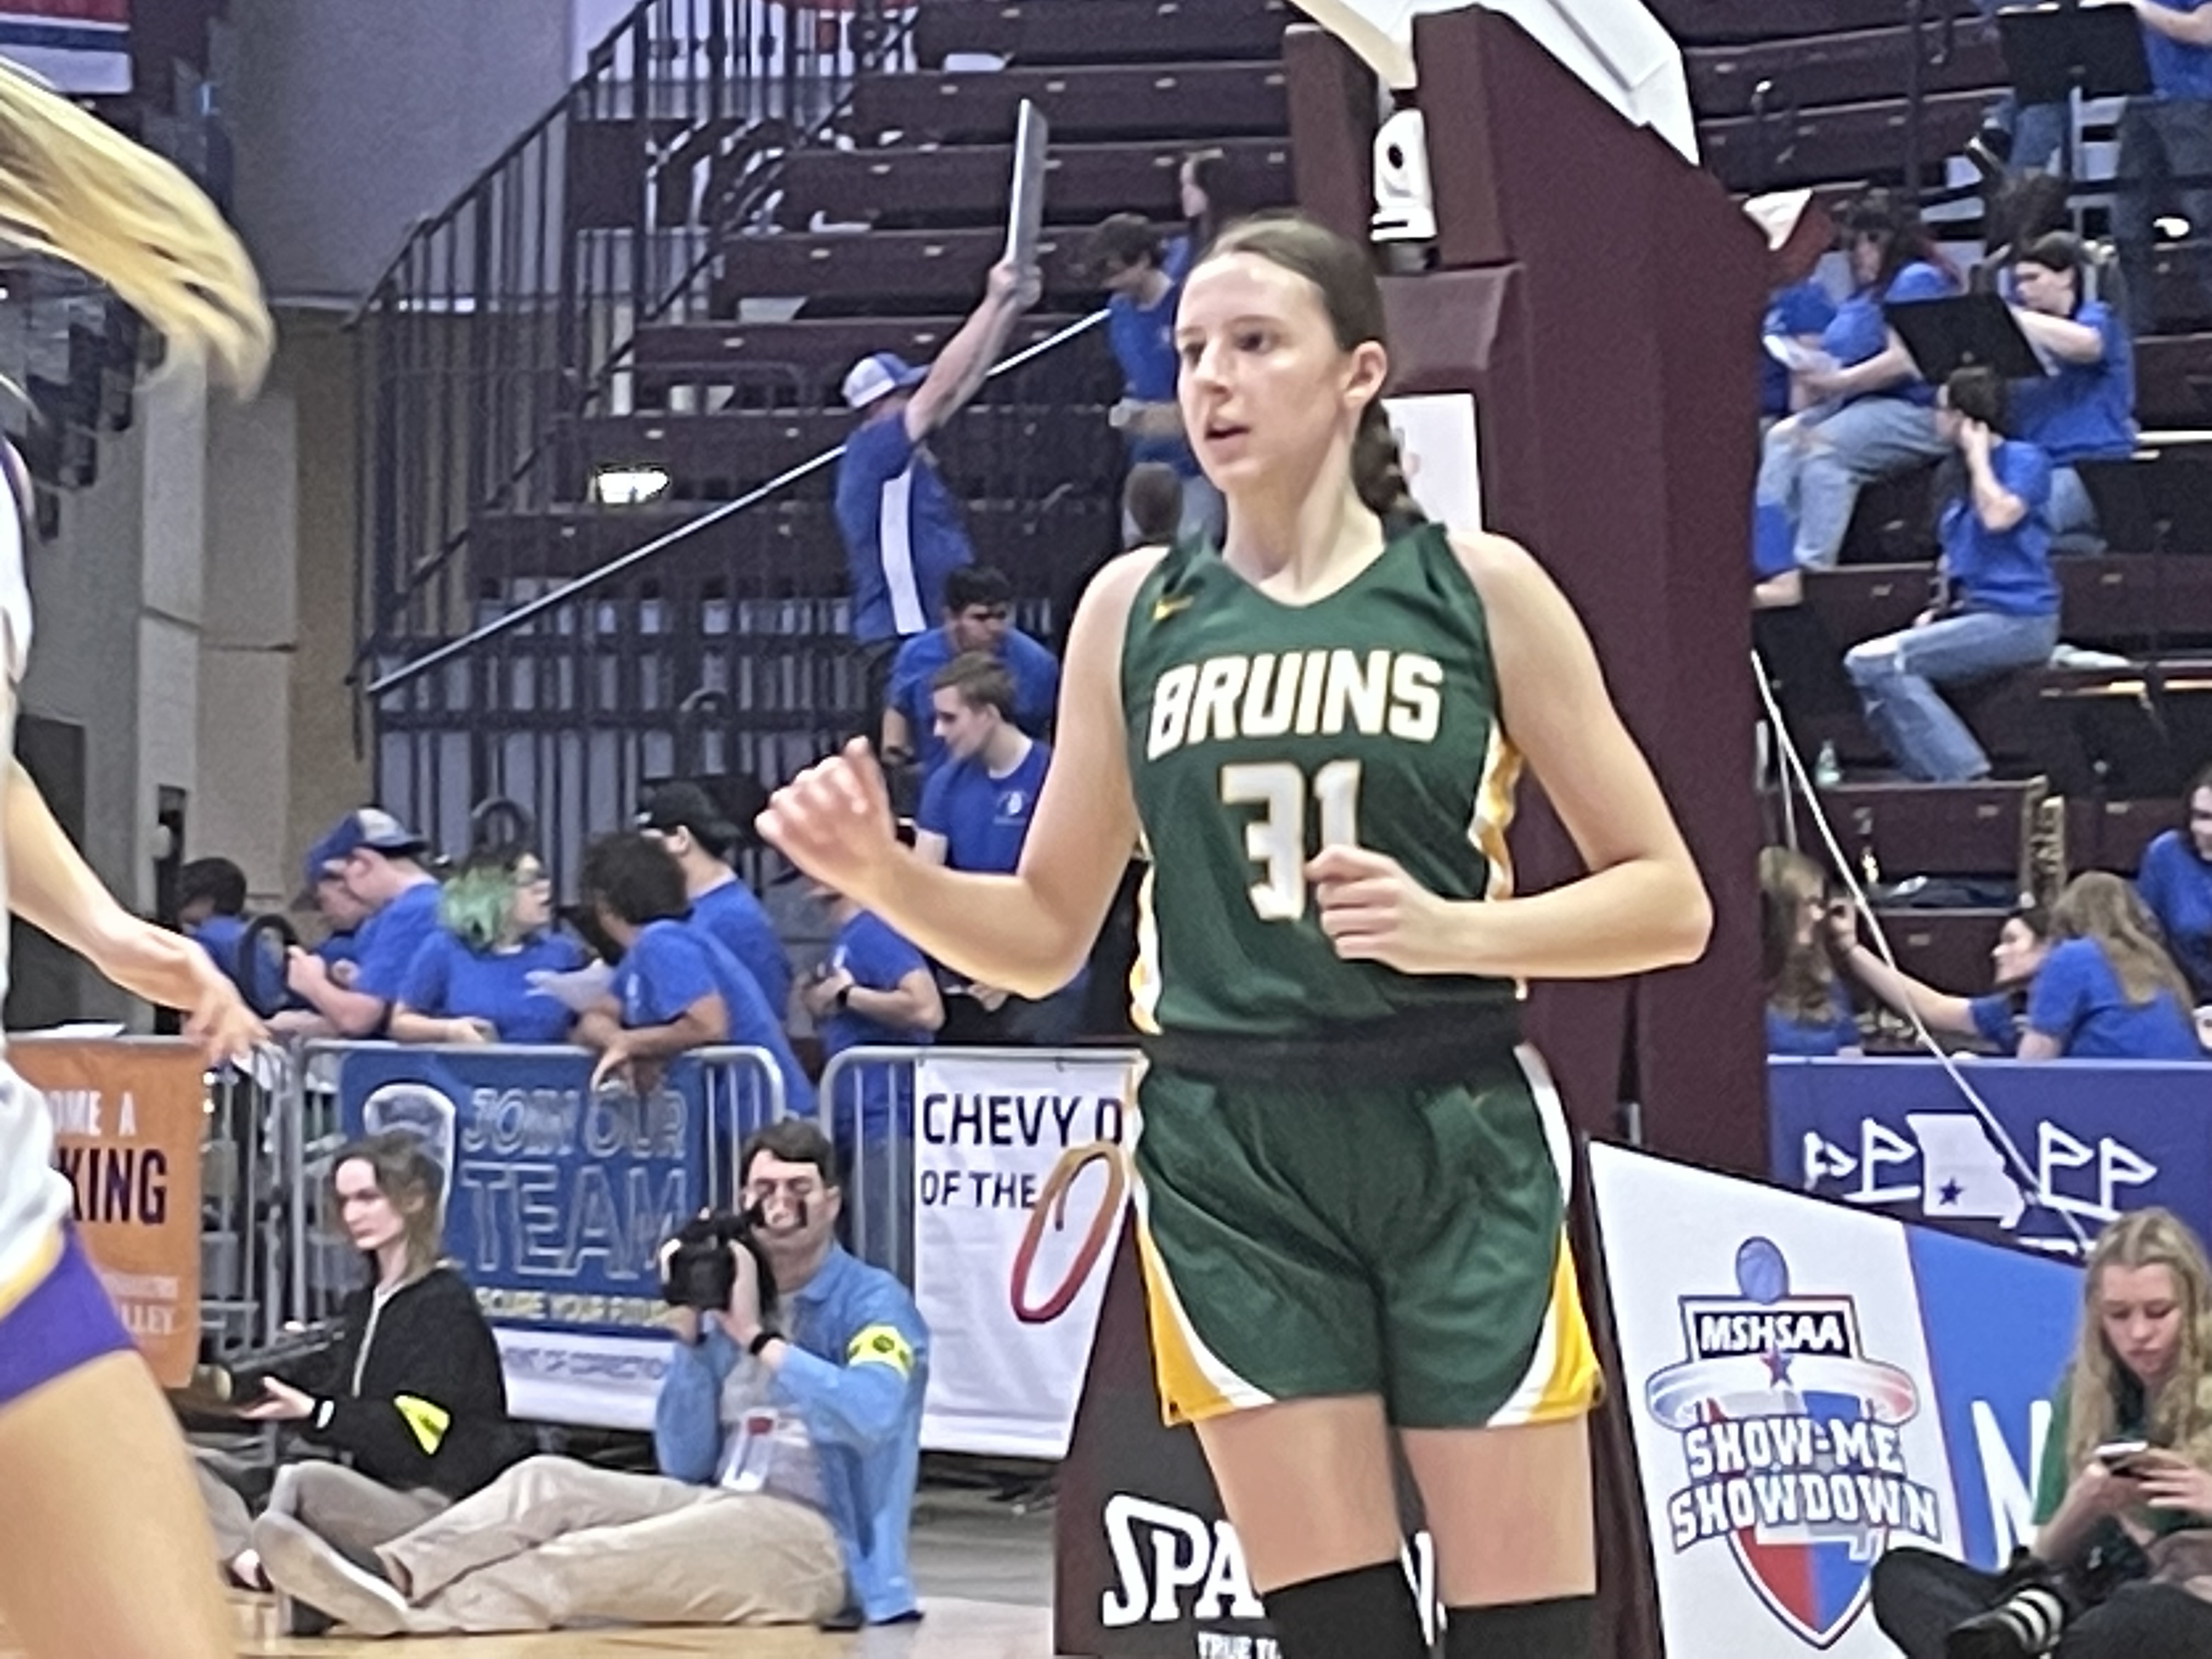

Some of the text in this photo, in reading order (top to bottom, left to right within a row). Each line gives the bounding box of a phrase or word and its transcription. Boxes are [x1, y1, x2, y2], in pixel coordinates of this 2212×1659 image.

[1147, 649, 1444, 760] BRUINS
[1221, 759, 1362, 922] 31
[119, 1092, 136, 1136] A
[584, 1084, 688, 1159] OUR
[923, 1094, 1082, 1146] CHEVY
[57, 1148, 167, 1224] KING
[460, 1160, 686, 1280] TEAM
[921, 1170, 1037, 1209] OF THE
[1700, 1315, 1844, 1352] MSHSAA
[1685, 1418, 1904, 1477] SHOW-ME
[1670, 1475, 1938, 1545] SHOWDOWN
[1102, 1494, 1265, 1626] SPA
